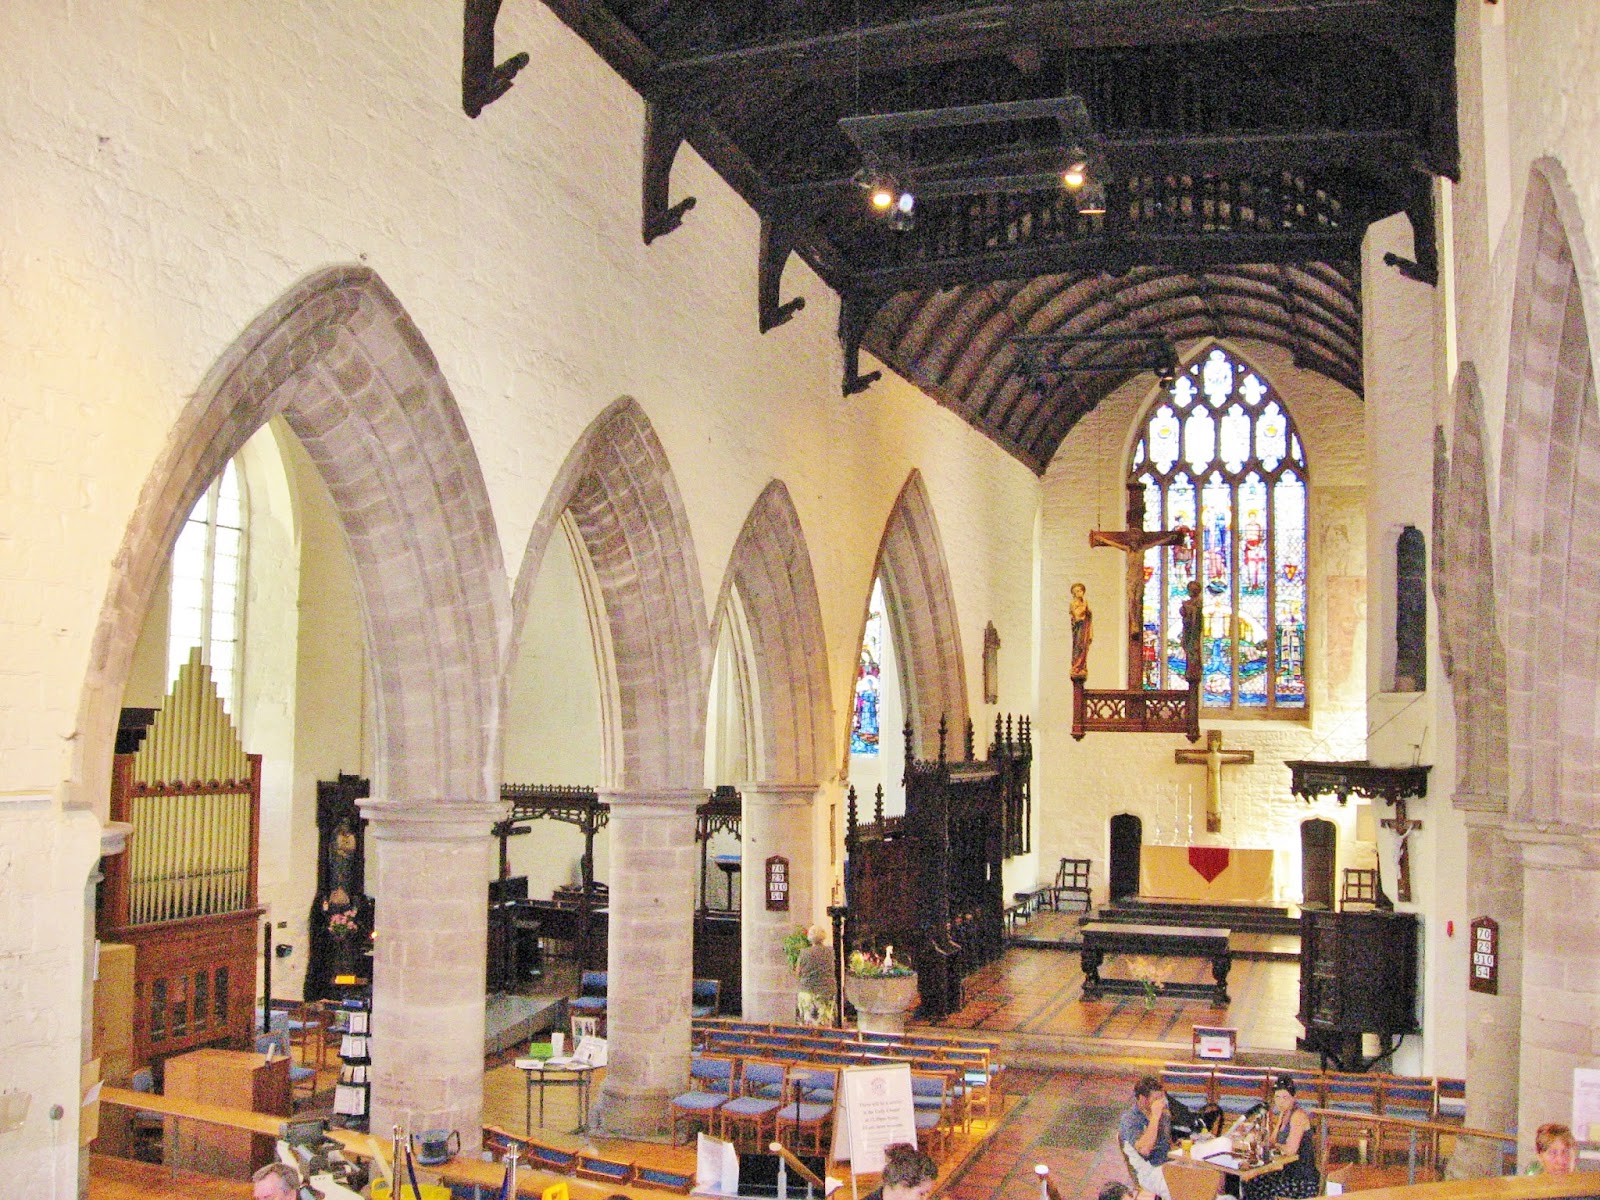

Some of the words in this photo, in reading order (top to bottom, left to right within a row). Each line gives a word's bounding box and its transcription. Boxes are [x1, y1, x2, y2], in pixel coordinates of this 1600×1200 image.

[773, 874, 783, 882] 29
[771, 883, 787, 891] 310
[1479, 929, 1490, 939] 70
[1478, 942, 1489, 952] 29
[1475, 954, 1492, 965] 310
[1477, 967, 1488, 977] 54
